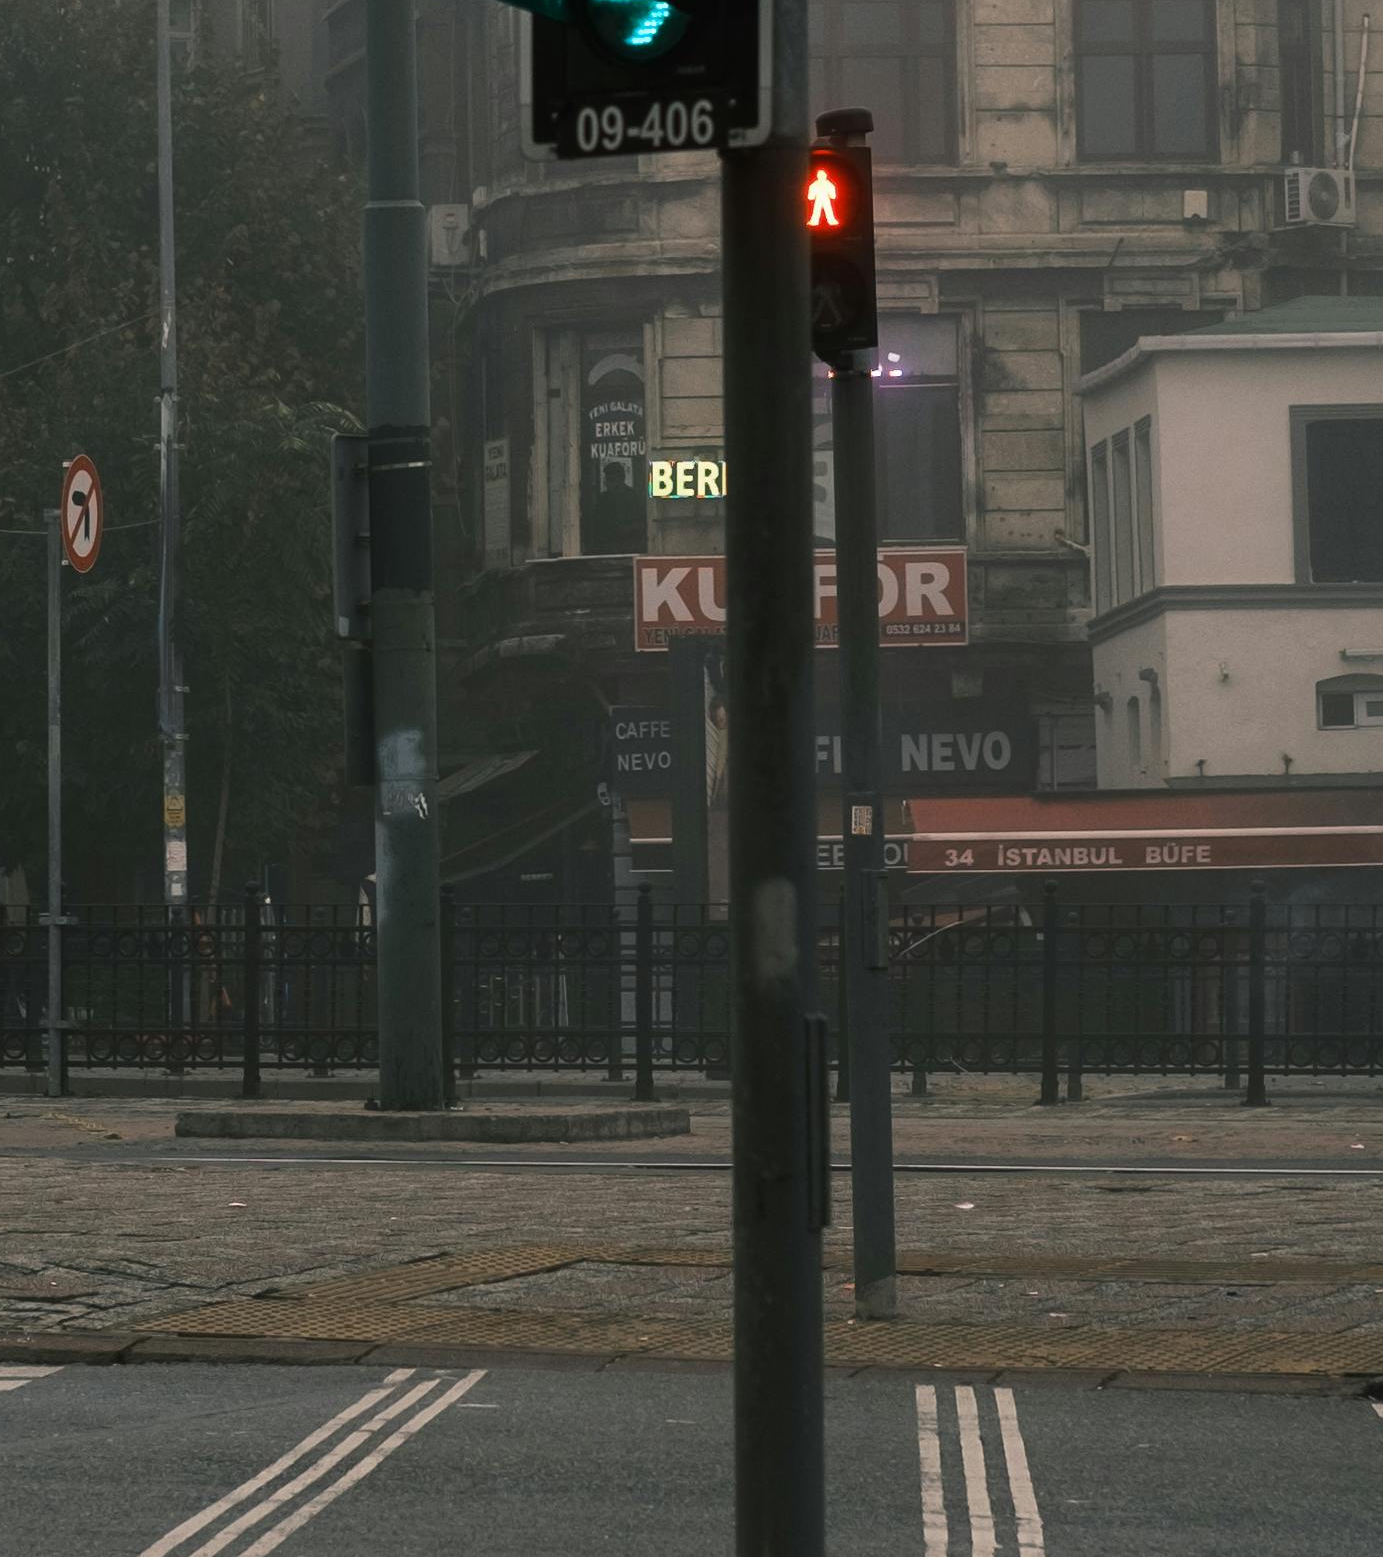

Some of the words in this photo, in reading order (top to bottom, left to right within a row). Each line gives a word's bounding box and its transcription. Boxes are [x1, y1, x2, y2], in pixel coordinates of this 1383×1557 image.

[576, 98, 715, 153] 09-406
[595, 421, 635, 438] ERKEK
[615, 720, 672, 741] CAFFE
[616, 750, 672, 772] NEVO
[900, 730, 1012, 772] NEVO
[944, 848, 975, 867] 34
[997, 843, 1123, 867] İSTANBUL
[1145, 842, 1213, 865] BÜFE
